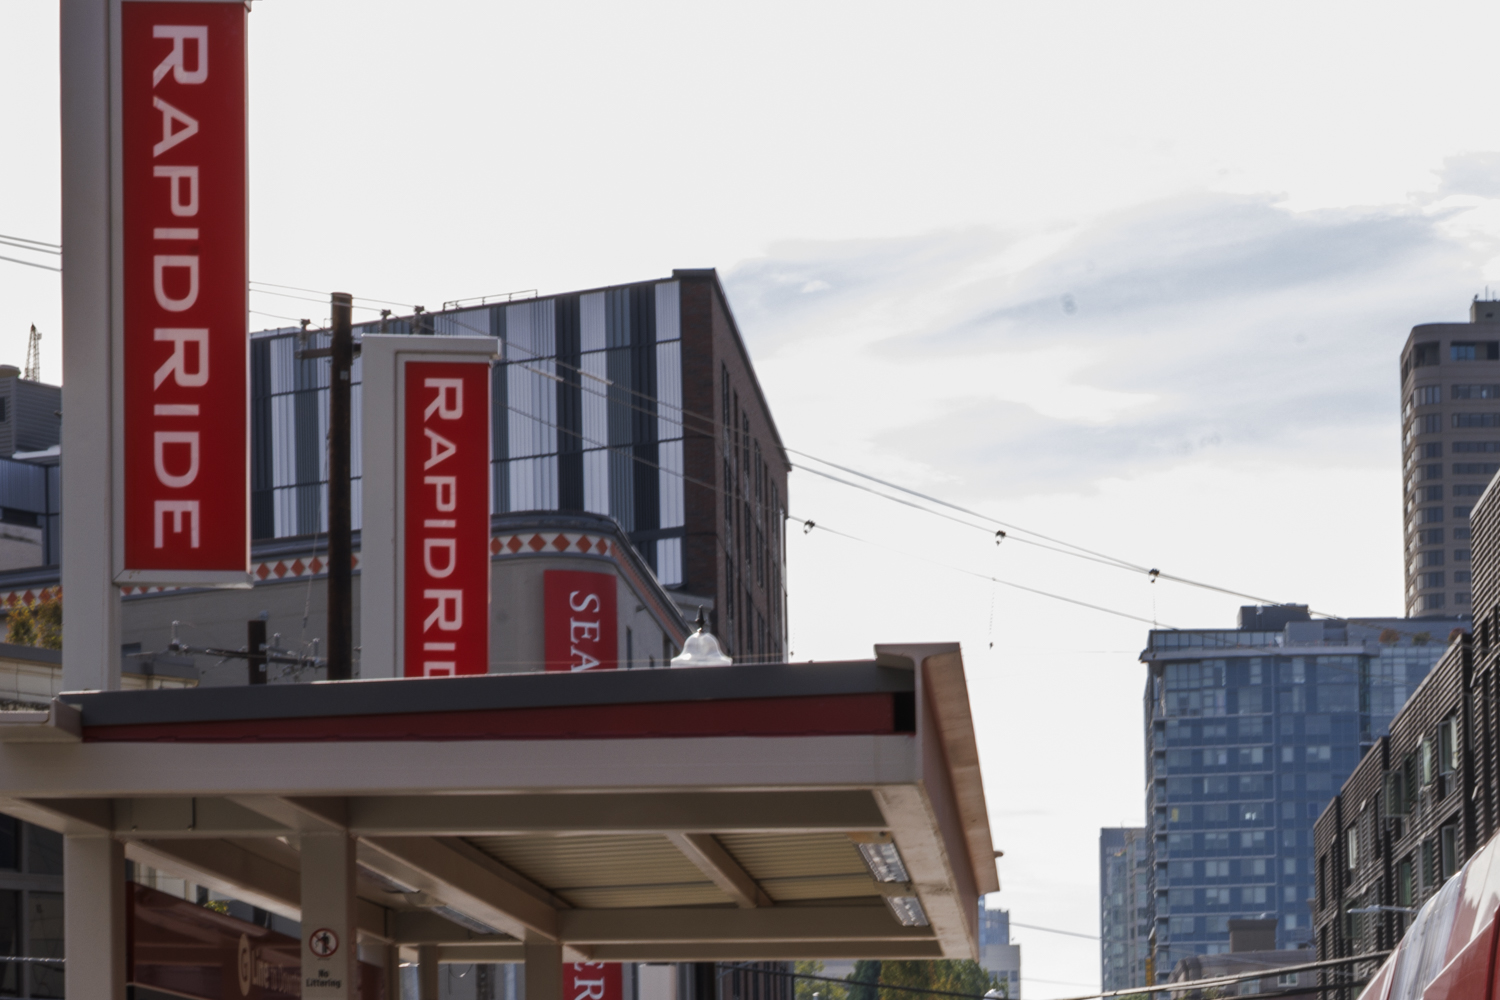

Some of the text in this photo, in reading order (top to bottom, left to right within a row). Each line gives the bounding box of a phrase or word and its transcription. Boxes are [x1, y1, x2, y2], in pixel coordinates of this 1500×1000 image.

[152, 24, 209, 550] RAPIDRIDE
[318, 968, 329, 977] No
[305, 978, 342, 989] Littering
